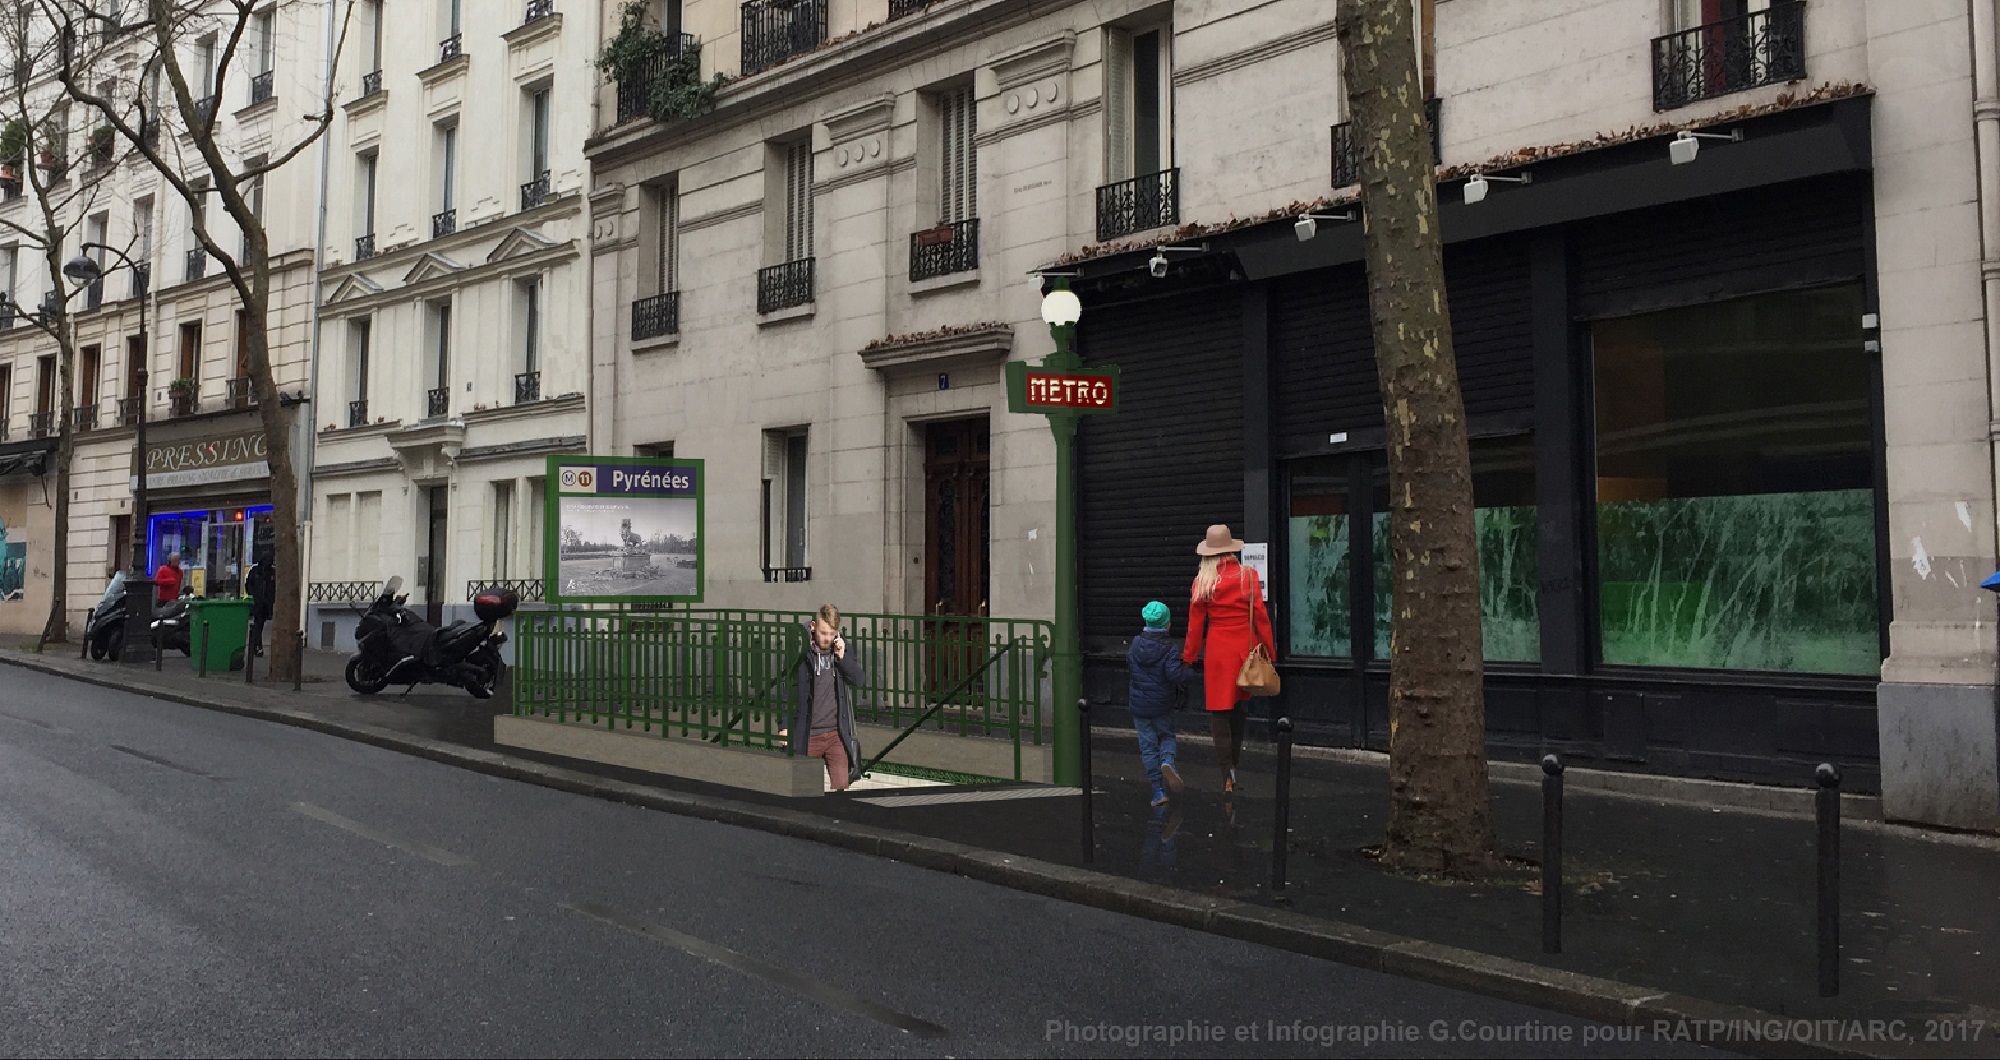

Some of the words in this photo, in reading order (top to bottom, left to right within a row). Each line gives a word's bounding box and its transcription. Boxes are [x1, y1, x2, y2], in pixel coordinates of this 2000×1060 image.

[1031, 377, 1107, 405] METRO
[146, 433, 268, 470] PRESSING
[580, 474, 590, 484] 11
[612, 469, 689, 492] Pyrénées
